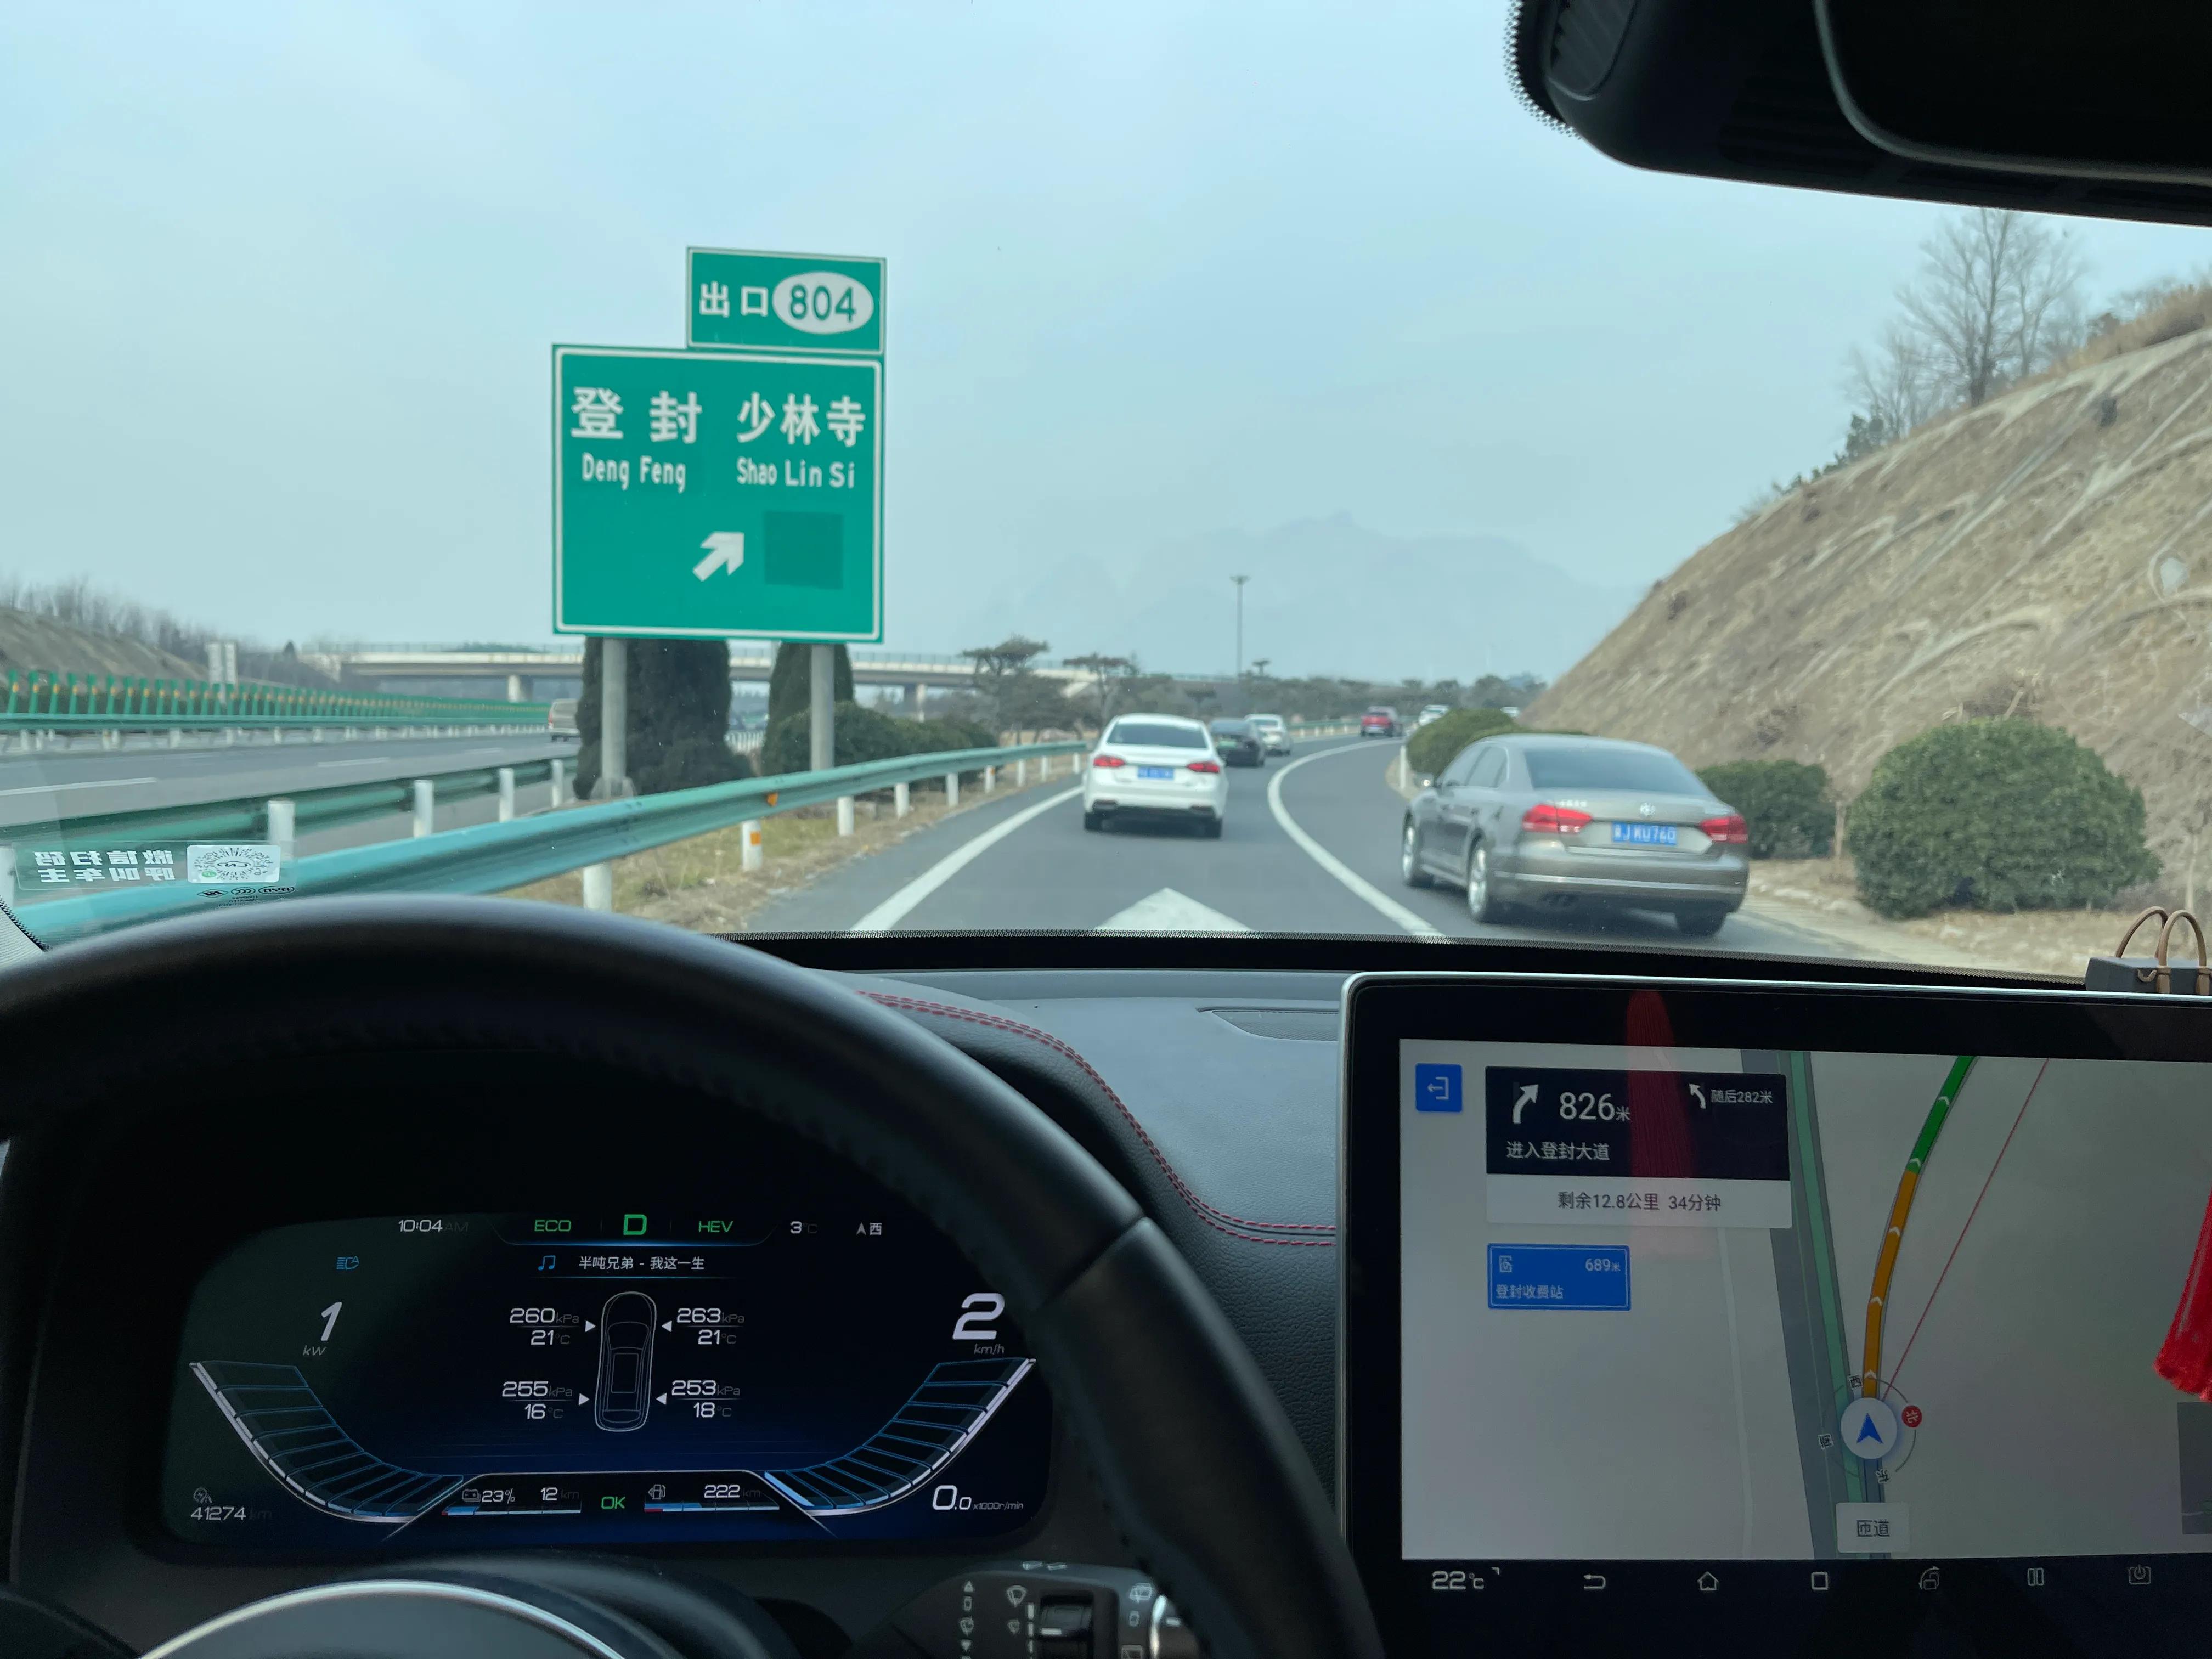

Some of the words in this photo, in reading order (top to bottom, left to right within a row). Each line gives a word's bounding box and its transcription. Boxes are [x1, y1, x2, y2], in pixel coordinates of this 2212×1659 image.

[699, 281, 768, 318] 出口
[788, 284, 856, 323] 804
[571, 386, 702, 444] 登封
[737, 391, 866, 448] 少林寺
[582, 452, 630, 490] Deng
[640, 455, 686, 494] Feng
[737, 458, 777, 486] Shao
[785, 460, 822, 487] Lin
[829, 462, 855, 488] Si
[1711, 1089, 1773, 1105] 随后282米
[1559, 1092, 1632, 1122] 826米
[1506, 1141, 1610, 1161] 进入登封大道
[1558, 1190, 1660, 1211] 剩余12.8公里
[1668, 1193, 1722, 1212] 34分钟
[398, 1219, 443, 1233] 10:04
[534, 1220, 572, 1232] ECO
[623, 1214, 647, 1236] D
[698, 1220, 734, 1233] HEV
[869, 1222, 883, 1235] 西
[579, 1256, 634, 1271] 半吨兄弟
[650, 1256, 704, 1271] 我这一生
[1585, 1258, 1621, 1273] 689米
[1495, 1284, 1564, 1301] 登封收费站
[320, 1301, 343, 1341] 1
[952, 1292, 1006, 1340] 2
[302, 1345, 326, 1356] kW
[974, 1343, 1005, 1356] km/h
[481, 1488, 516, 1504] 23%
[540, 1487, 557, 1502] 12
[601, 1496, 627, 1510] OK
[190, 1506, 246, 1521] 41274
[1857, 1519, 1891, 1537] 匝道
